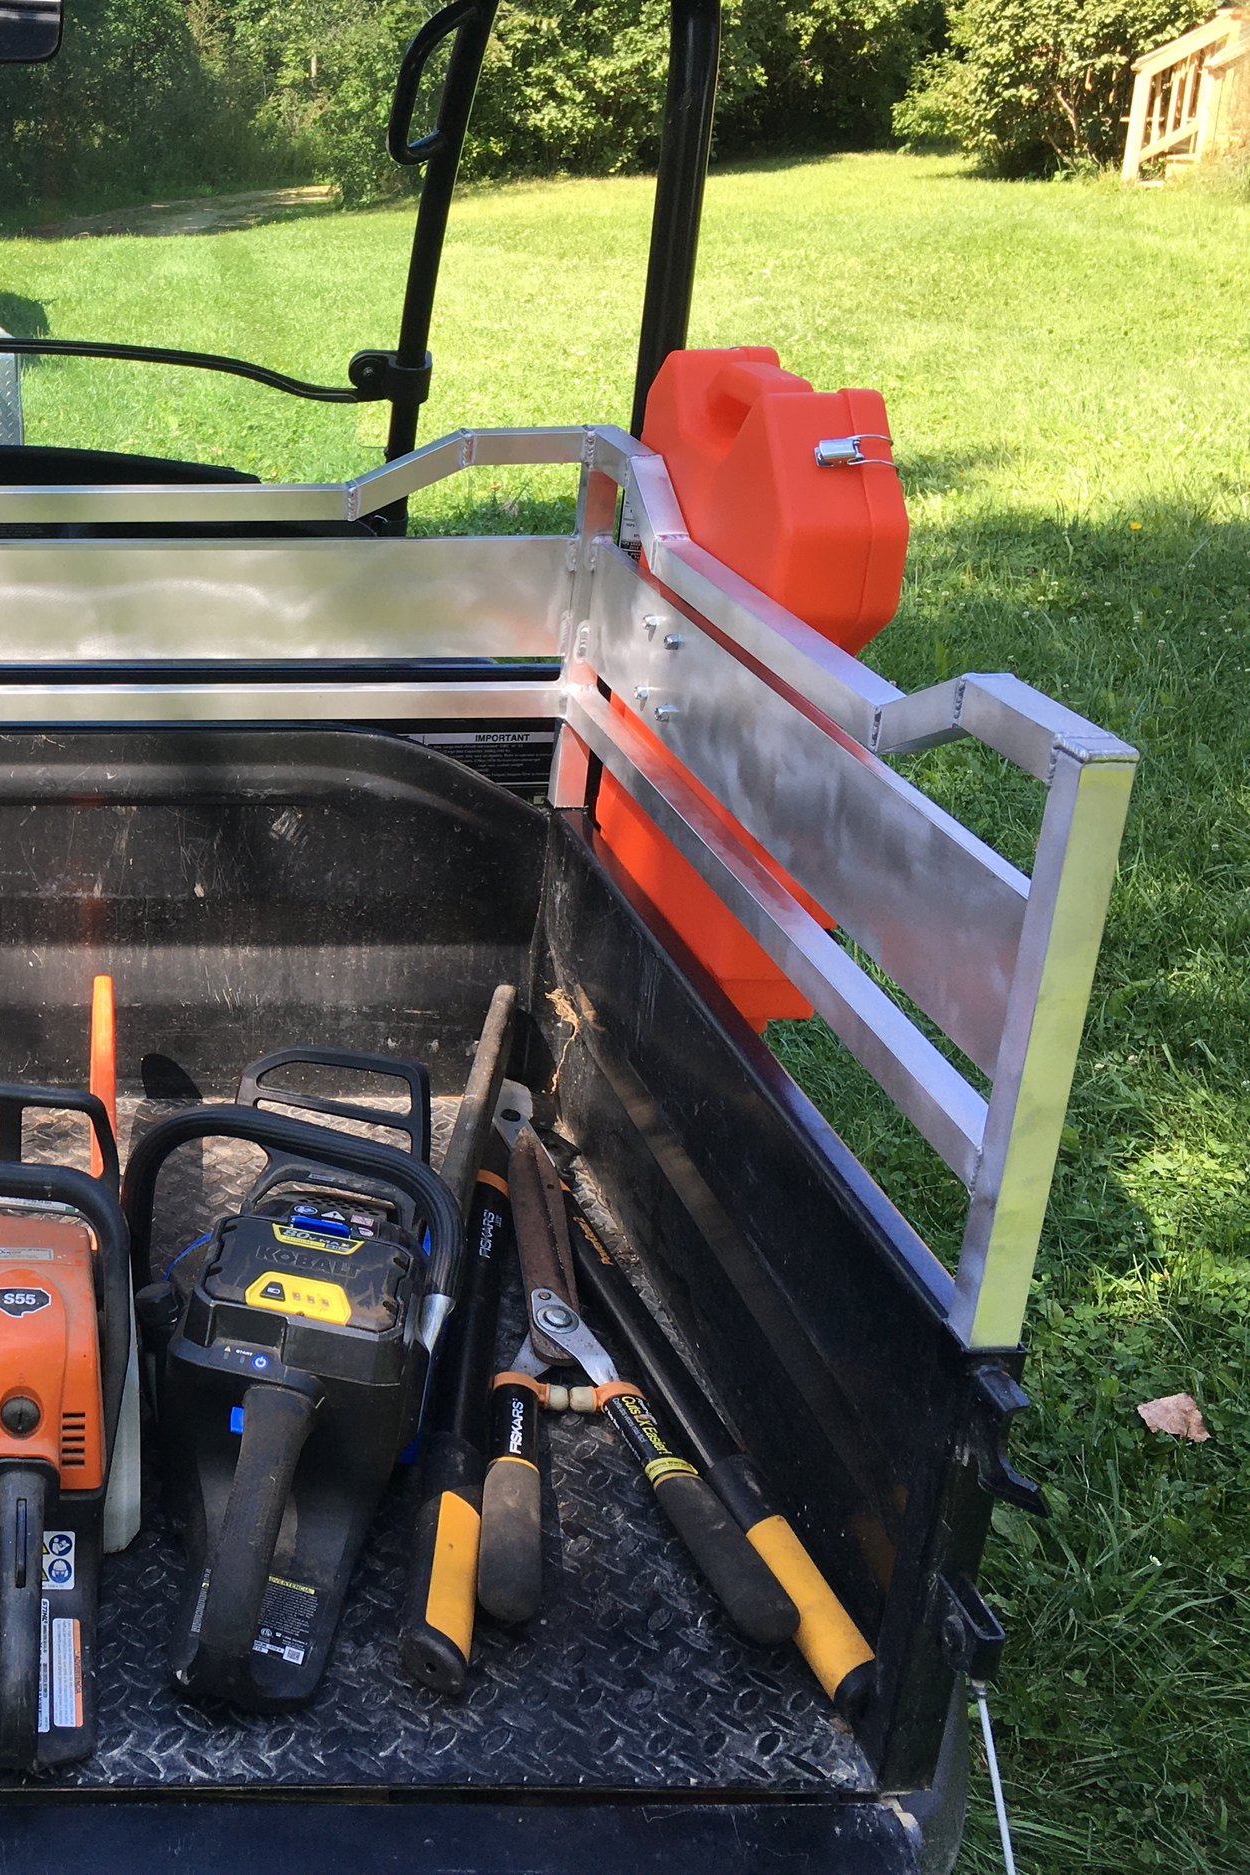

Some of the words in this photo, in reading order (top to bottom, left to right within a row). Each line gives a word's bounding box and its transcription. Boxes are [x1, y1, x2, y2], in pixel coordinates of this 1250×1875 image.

[475, 733, 530, 742] IMPORTANT
[319, 1238, 350, 1248] MAX
[255, 1245, 362, 1279] KOBALT
[3, 1293, 36, 1305] S55
[510, 1399, 524, 1455] FISKARS
[621, 1396, 642, 1416] Cuts
[642, 1426, 673, 1455] Easier!
